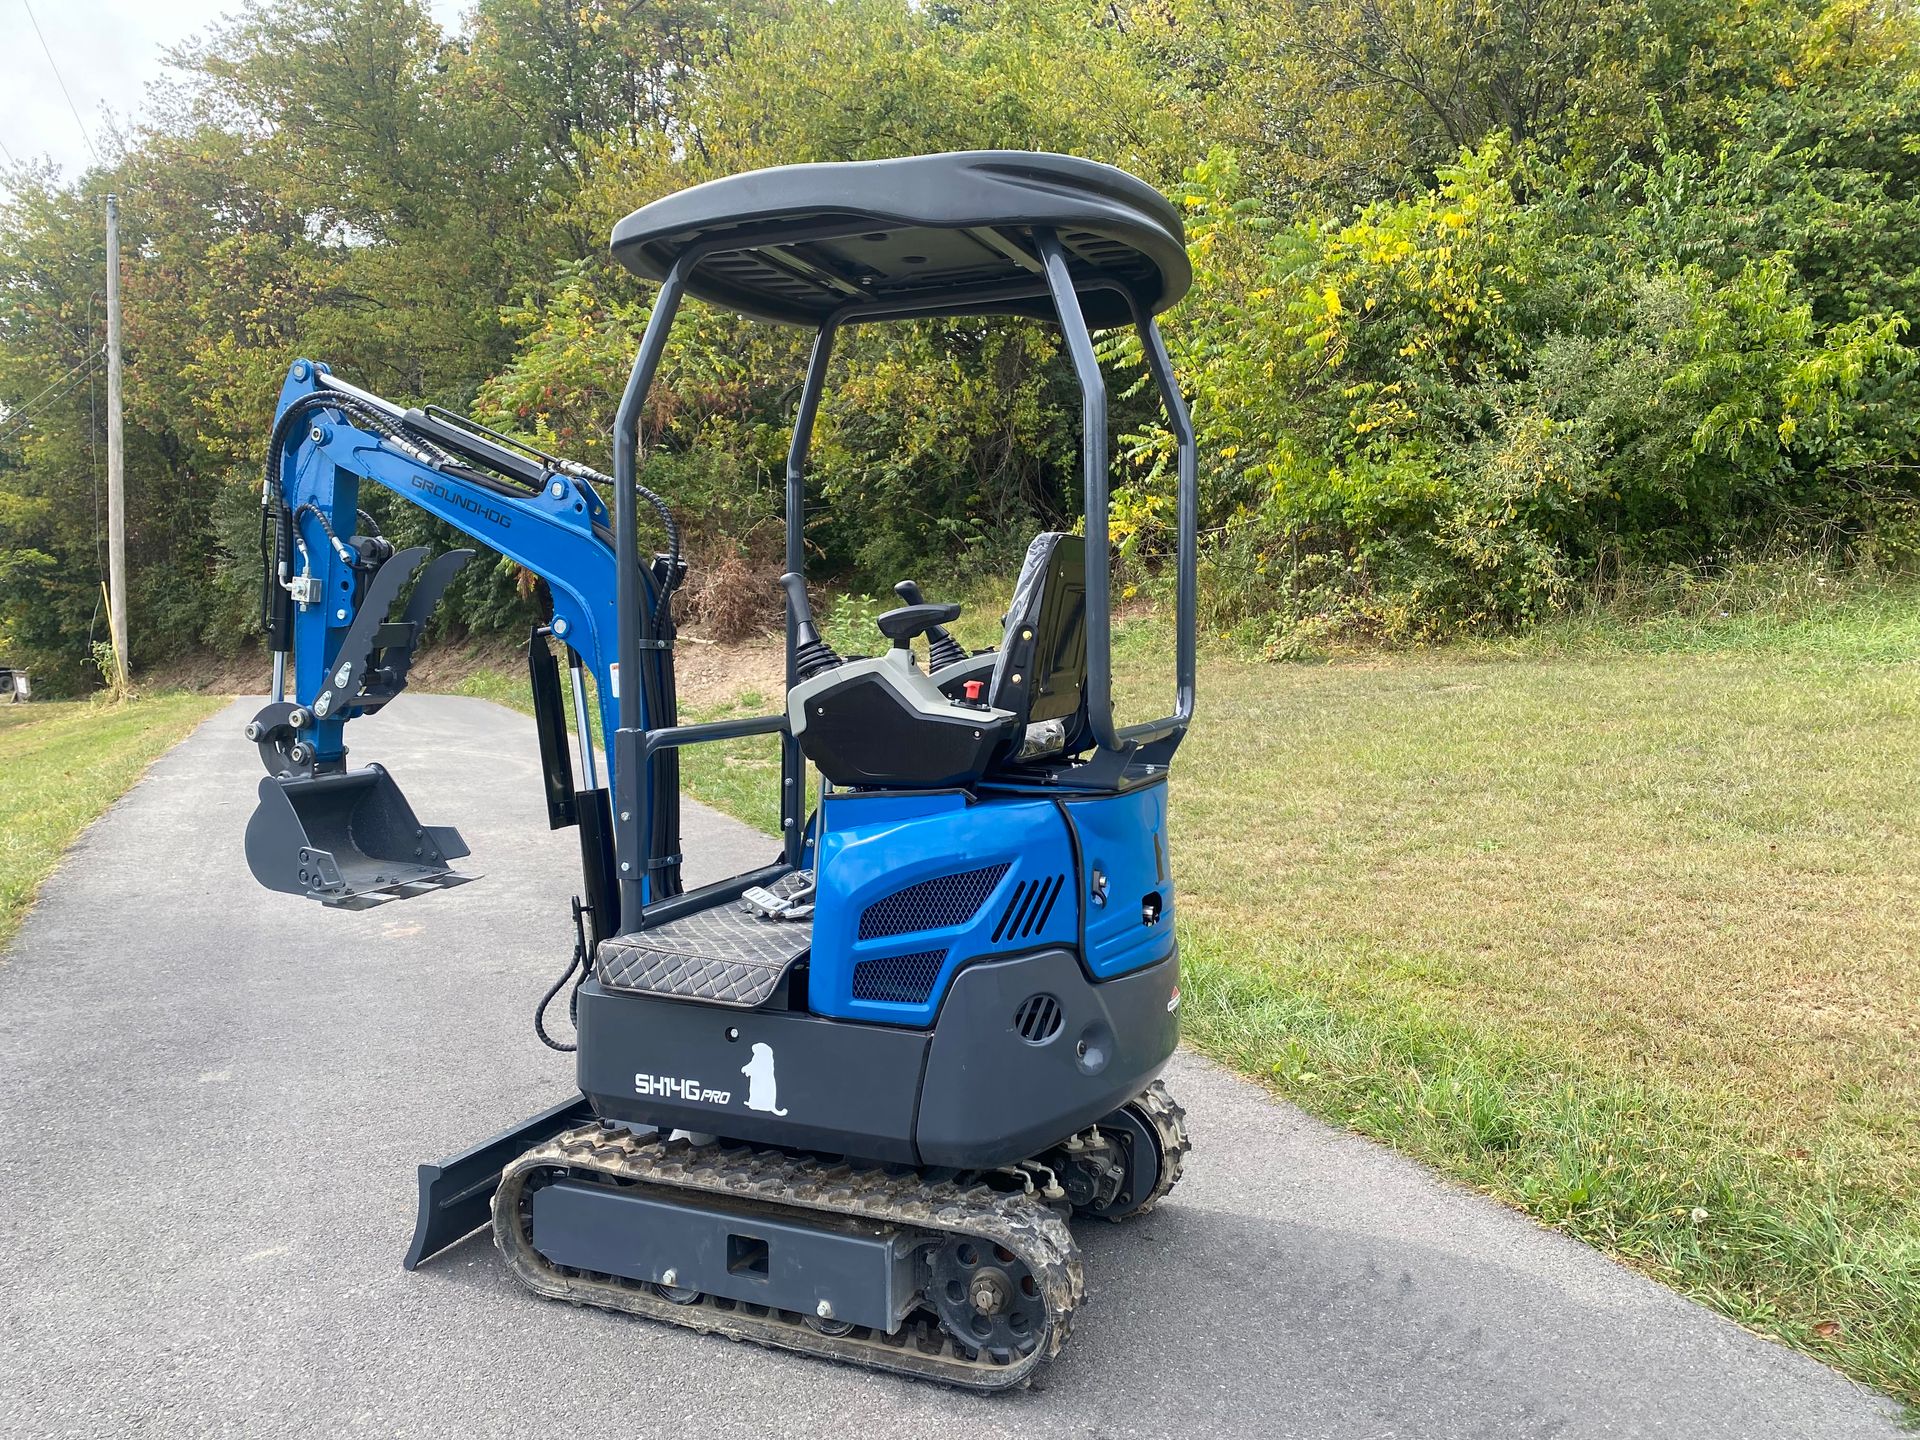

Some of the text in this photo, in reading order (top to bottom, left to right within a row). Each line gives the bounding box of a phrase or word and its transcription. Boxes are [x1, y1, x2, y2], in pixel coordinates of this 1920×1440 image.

[411, 475, 512, 528] GROUNDHOG
[635, 1073, 731, 1105] SH14G PRO
